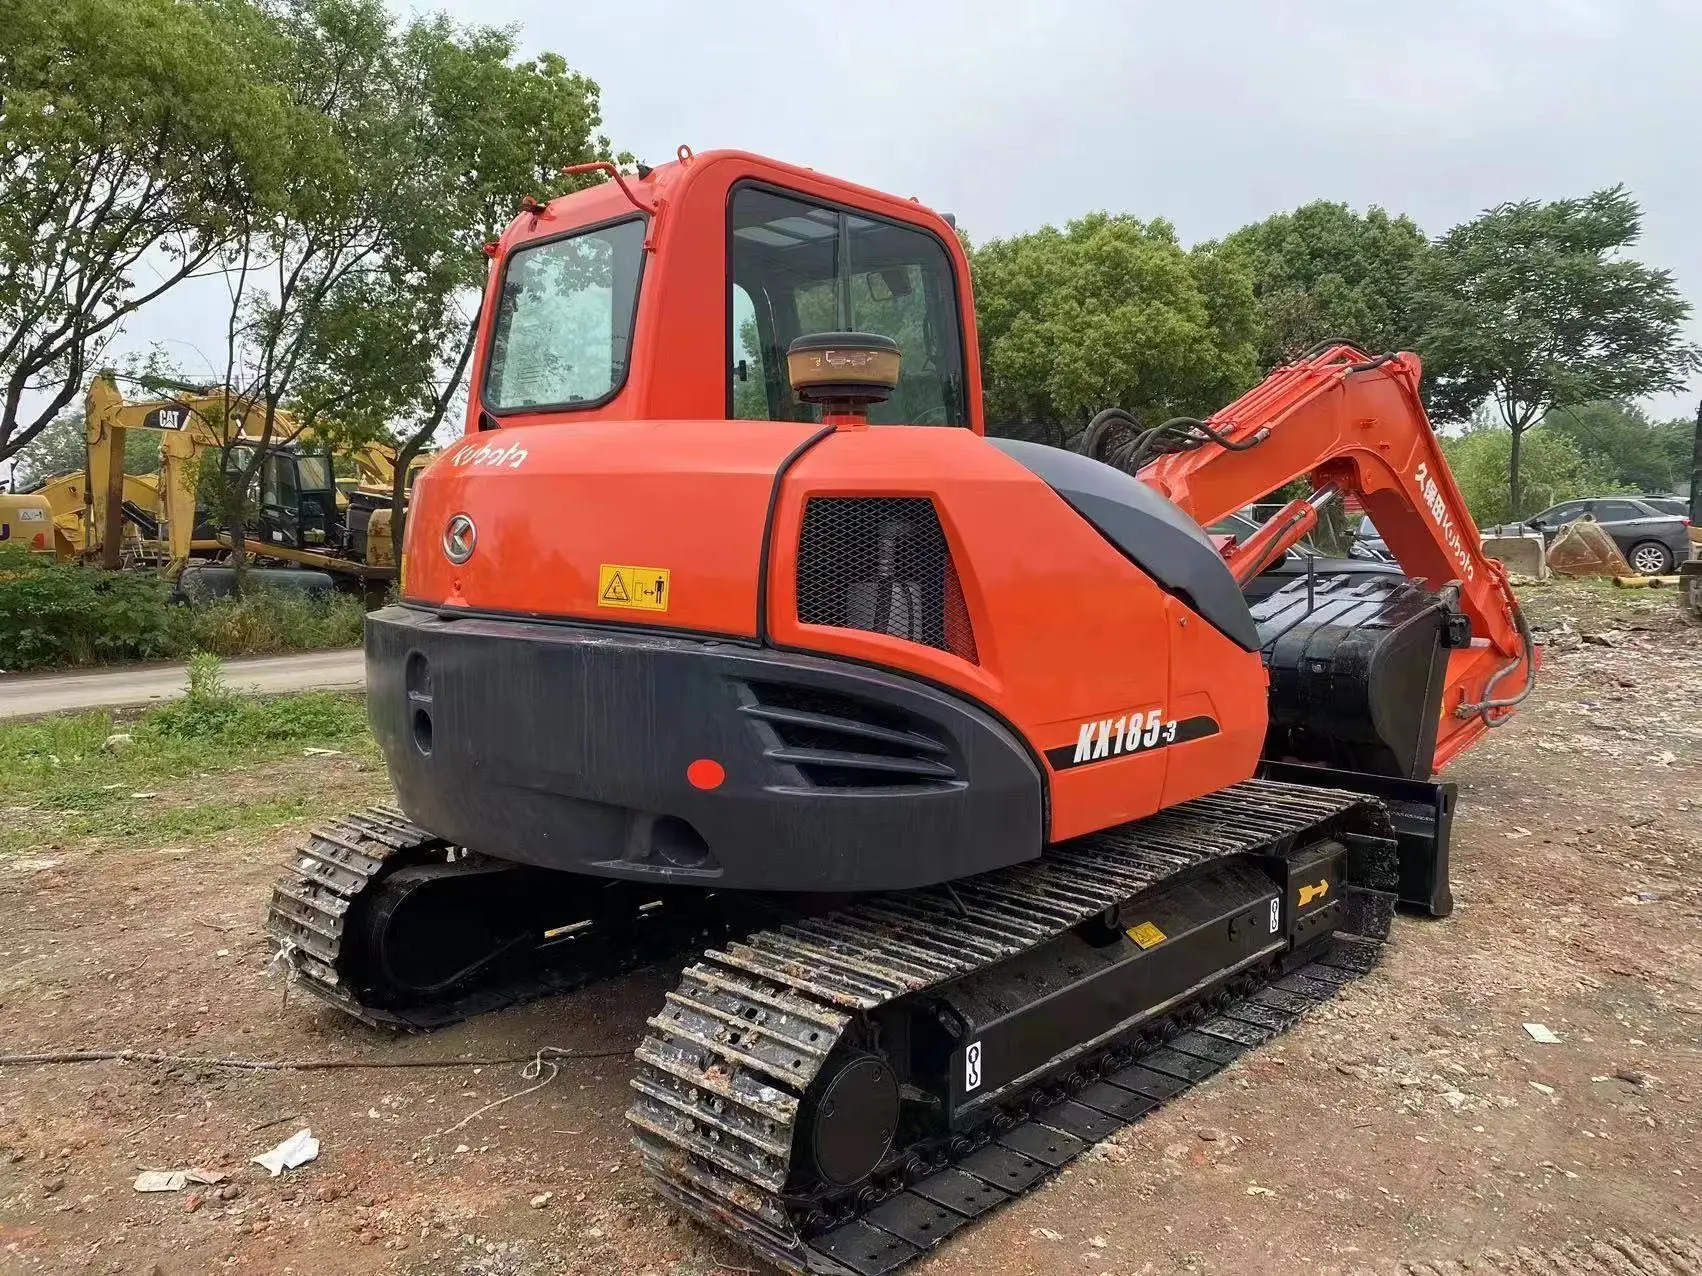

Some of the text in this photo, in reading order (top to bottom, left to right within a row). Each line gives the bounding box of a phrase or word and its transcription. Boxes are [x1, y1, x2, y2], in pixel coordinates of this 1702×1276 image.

[159, 409, 179, 428] CAT
[1415, 462, 1446, 526] 久保田
[1073, 709, 1177, 763] KX185-3
